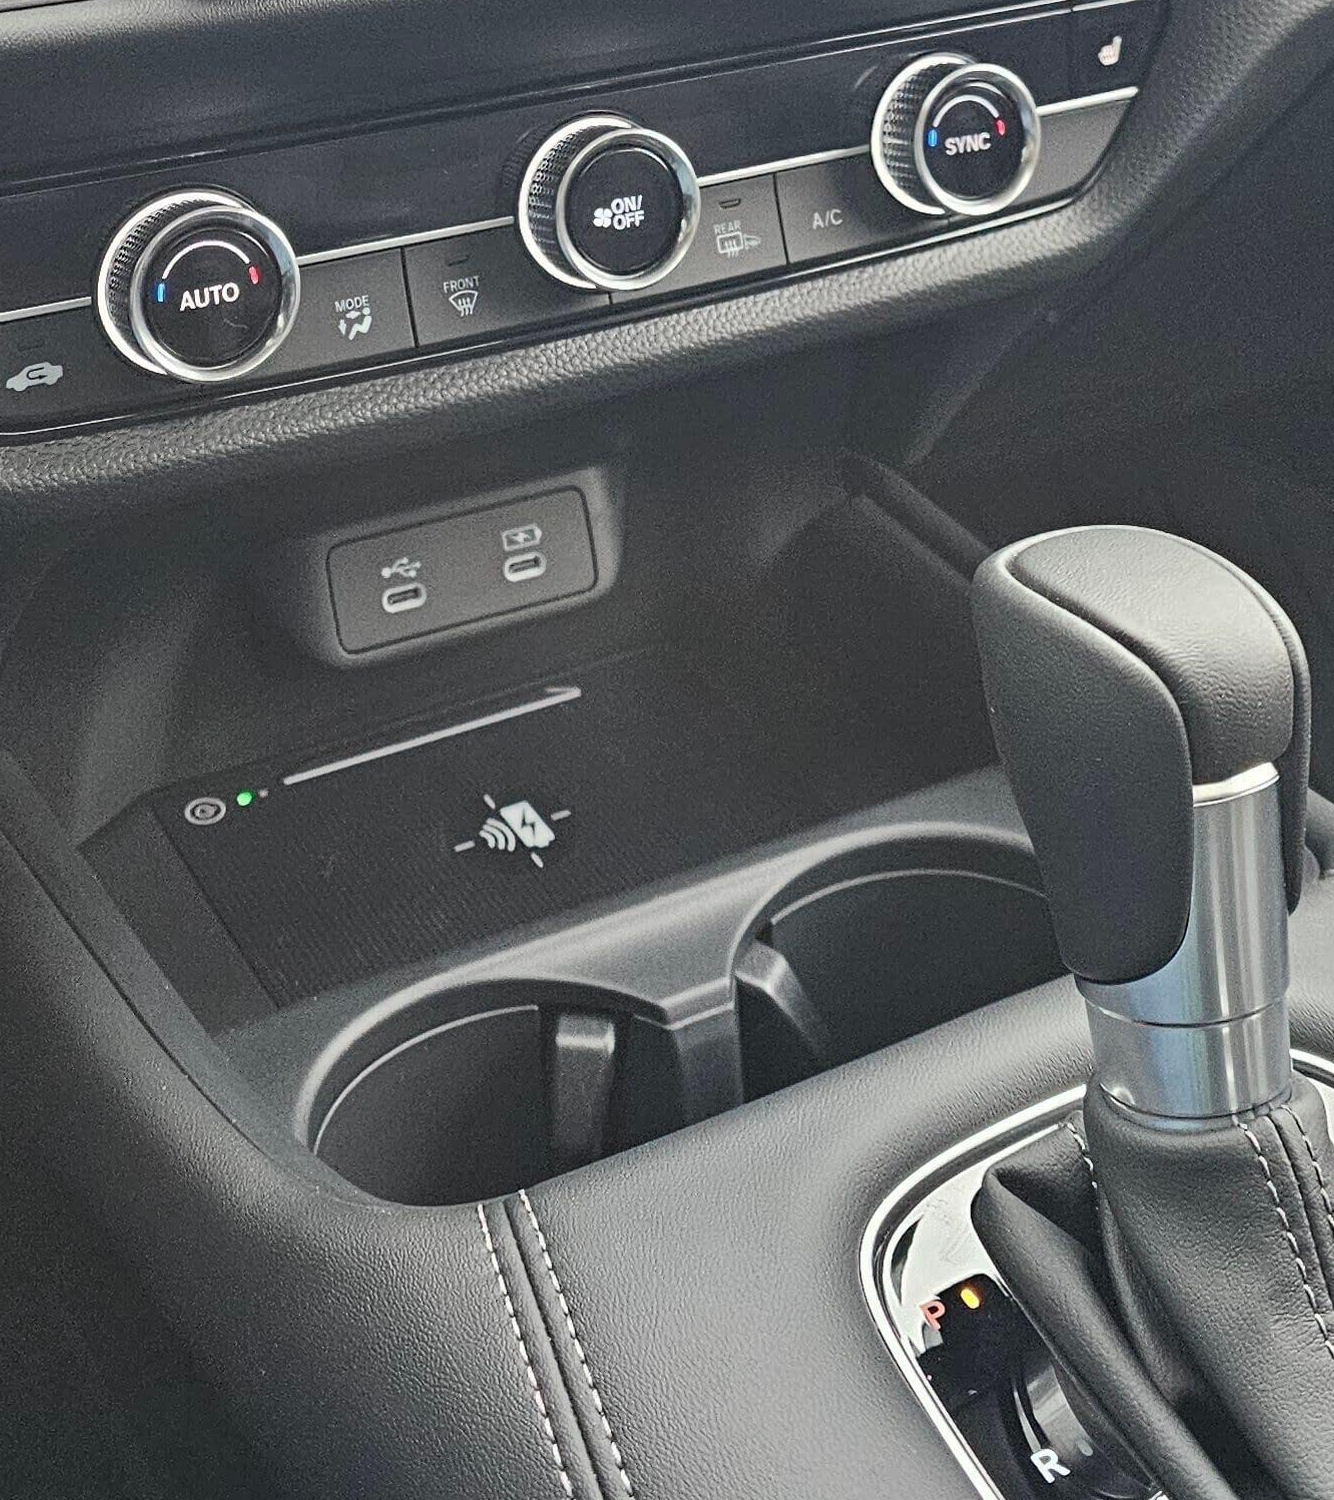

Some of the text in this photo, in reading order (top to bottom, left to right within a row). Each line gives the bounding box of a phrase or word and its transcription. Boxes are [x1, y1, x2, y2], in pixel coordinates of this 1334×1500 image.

[944, 131, 992, 157] SYNC
[610, 194, 644, 213] ON/
[612, 210, 645, 231] OFF
[714, 219, 742, 235] REAR
[812, 208, 843, 229] A/C
[442, 275, 480, 294] FRONT
[179, 281, 240, 312] AUTO
[334, 294, 370, 313] MODE
[920, 1299, 946, 1331] P
[1030, 1448, 1071, 1484] R
